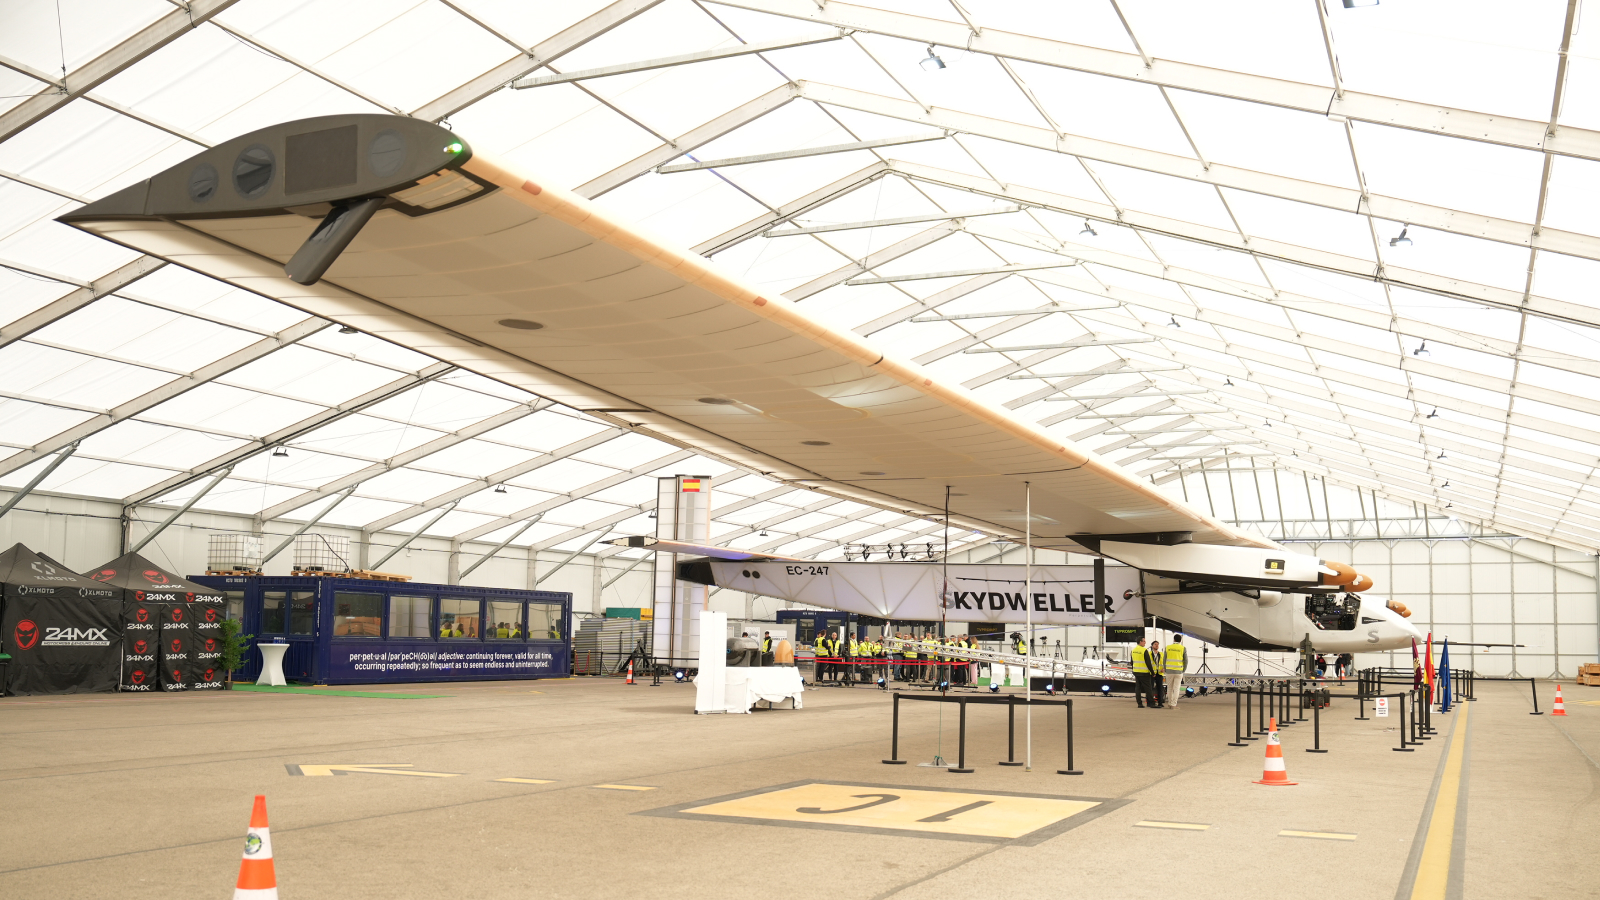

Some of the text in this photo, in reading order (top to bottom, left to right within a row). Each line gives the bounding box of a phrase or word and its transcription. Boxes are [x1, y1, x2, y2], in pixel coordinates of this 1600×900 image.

[786, 566, 828, 576] EC-247
[195, 595, 223, 603] 24MX
[938, 591, 1115, 613] SKYDWELLER
[44, 628, 108, 640] 24MX
[1367, 630, 1380, 643] S
[438, 652, 464, 661] adjective:
[466, 652, 493, 661] continuing
[494, 652, 514, 660] forever,
[541, 652, 553, 660] time,
[354, 662, 386, 671] occurring
[386, 662, 421, 671] repeatedly;
[430, 661, 454, 670] frequent
[516, 661, 549, 669] uninterrupted.
